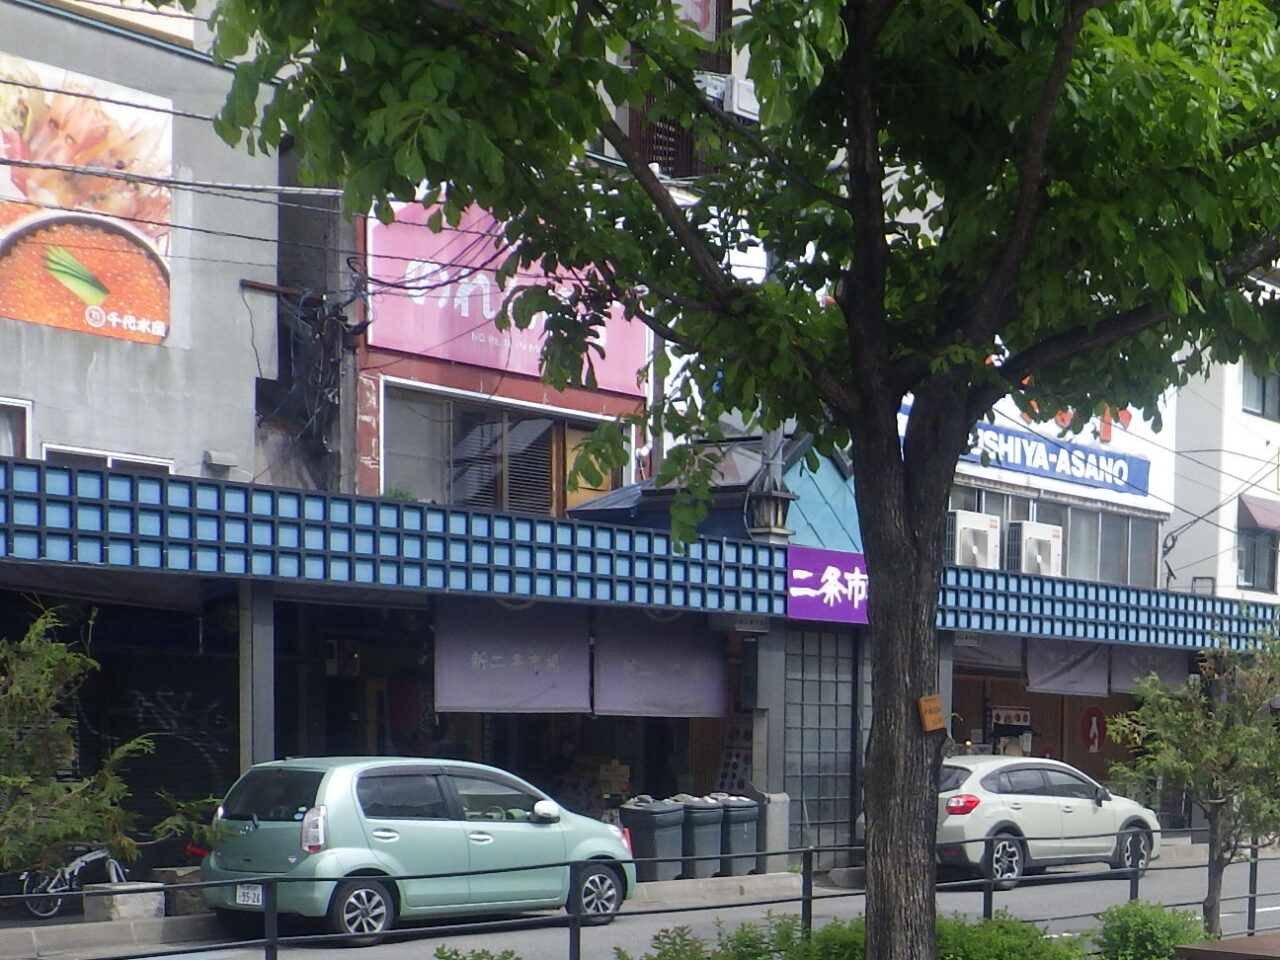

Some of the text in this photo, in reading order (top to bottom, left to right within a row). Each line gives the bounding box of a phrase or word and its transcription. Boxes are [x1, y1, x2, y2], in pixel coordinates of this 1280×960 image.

[968, 428, 1128, 486] USHIYA-ASANO
[789, 565, 868, 609] 二条市
